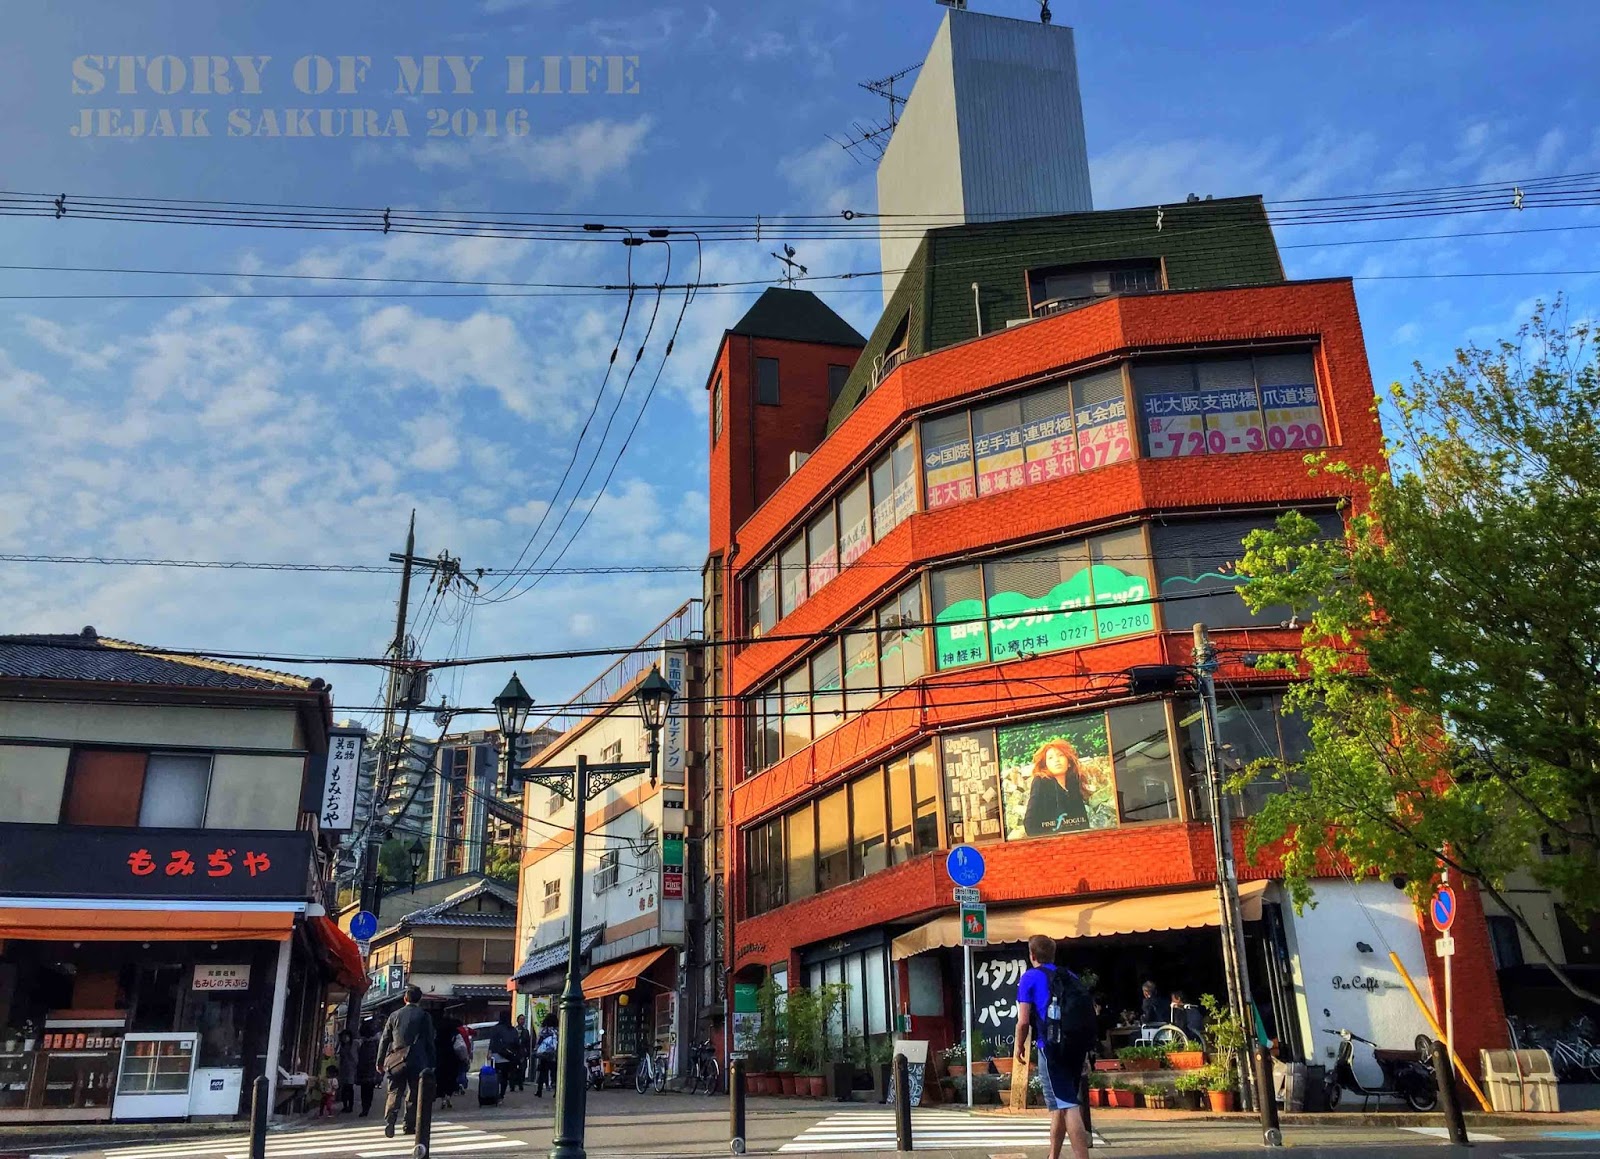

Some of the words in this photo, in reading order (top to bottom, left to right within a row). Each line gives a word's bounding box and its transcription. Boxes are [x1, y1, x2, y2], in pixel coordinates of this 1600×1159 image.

[942, 646, 983, 665] 神経科
[667, 657, 682, 768] 箕面駅ビルディング
[323, 765, 342, 828] もみぢや
[127, 848, 271, 877] もみぢや
[194, 978, 248, 988] もみじの天ぷら
